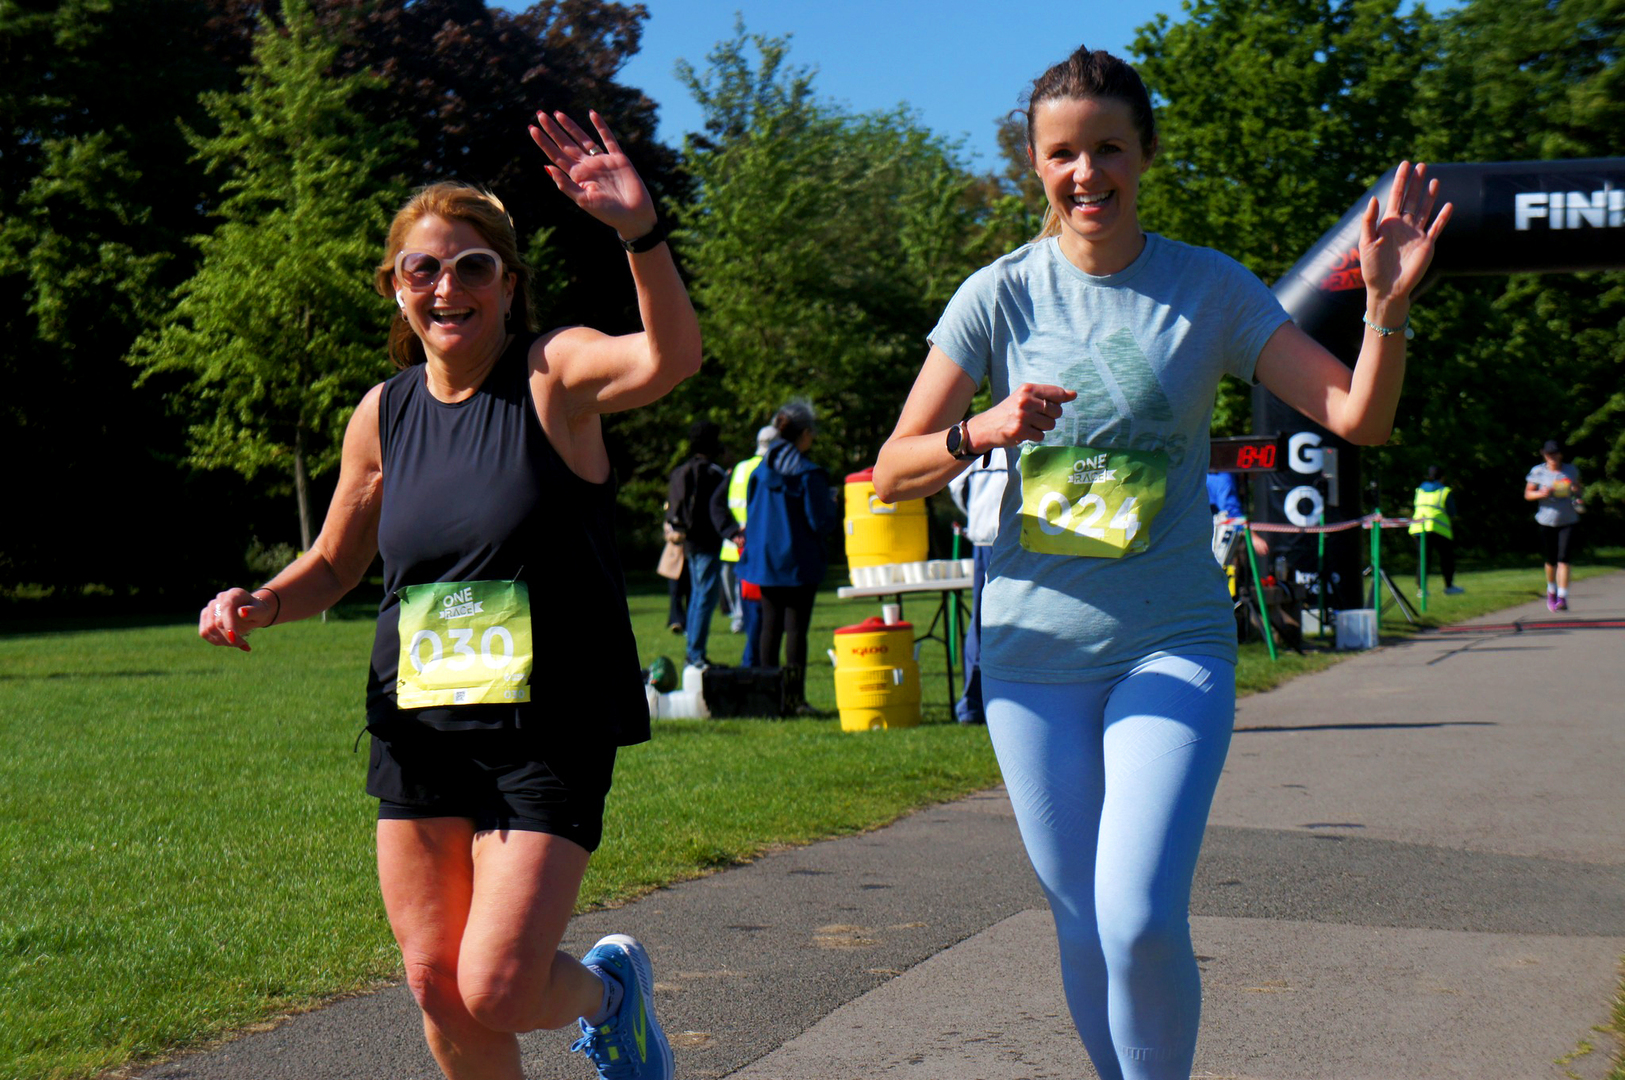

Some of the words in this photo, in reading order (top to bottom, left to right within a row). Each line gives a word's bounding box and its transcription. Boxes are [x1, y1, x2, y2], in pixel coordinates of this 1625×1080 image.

[1515, 190, 1625, 231] FINI
[1073, 453, 1107, 472] ONE
[1074, 472, 1104, 483] RACE
[1038, 491, 1142, 540] 024
[443, 587, 473, 607] ONE
[445, 606, 473, 618] RACE
[410, 626, 514, 673] 030
[504, 689, 525, 699] 030
